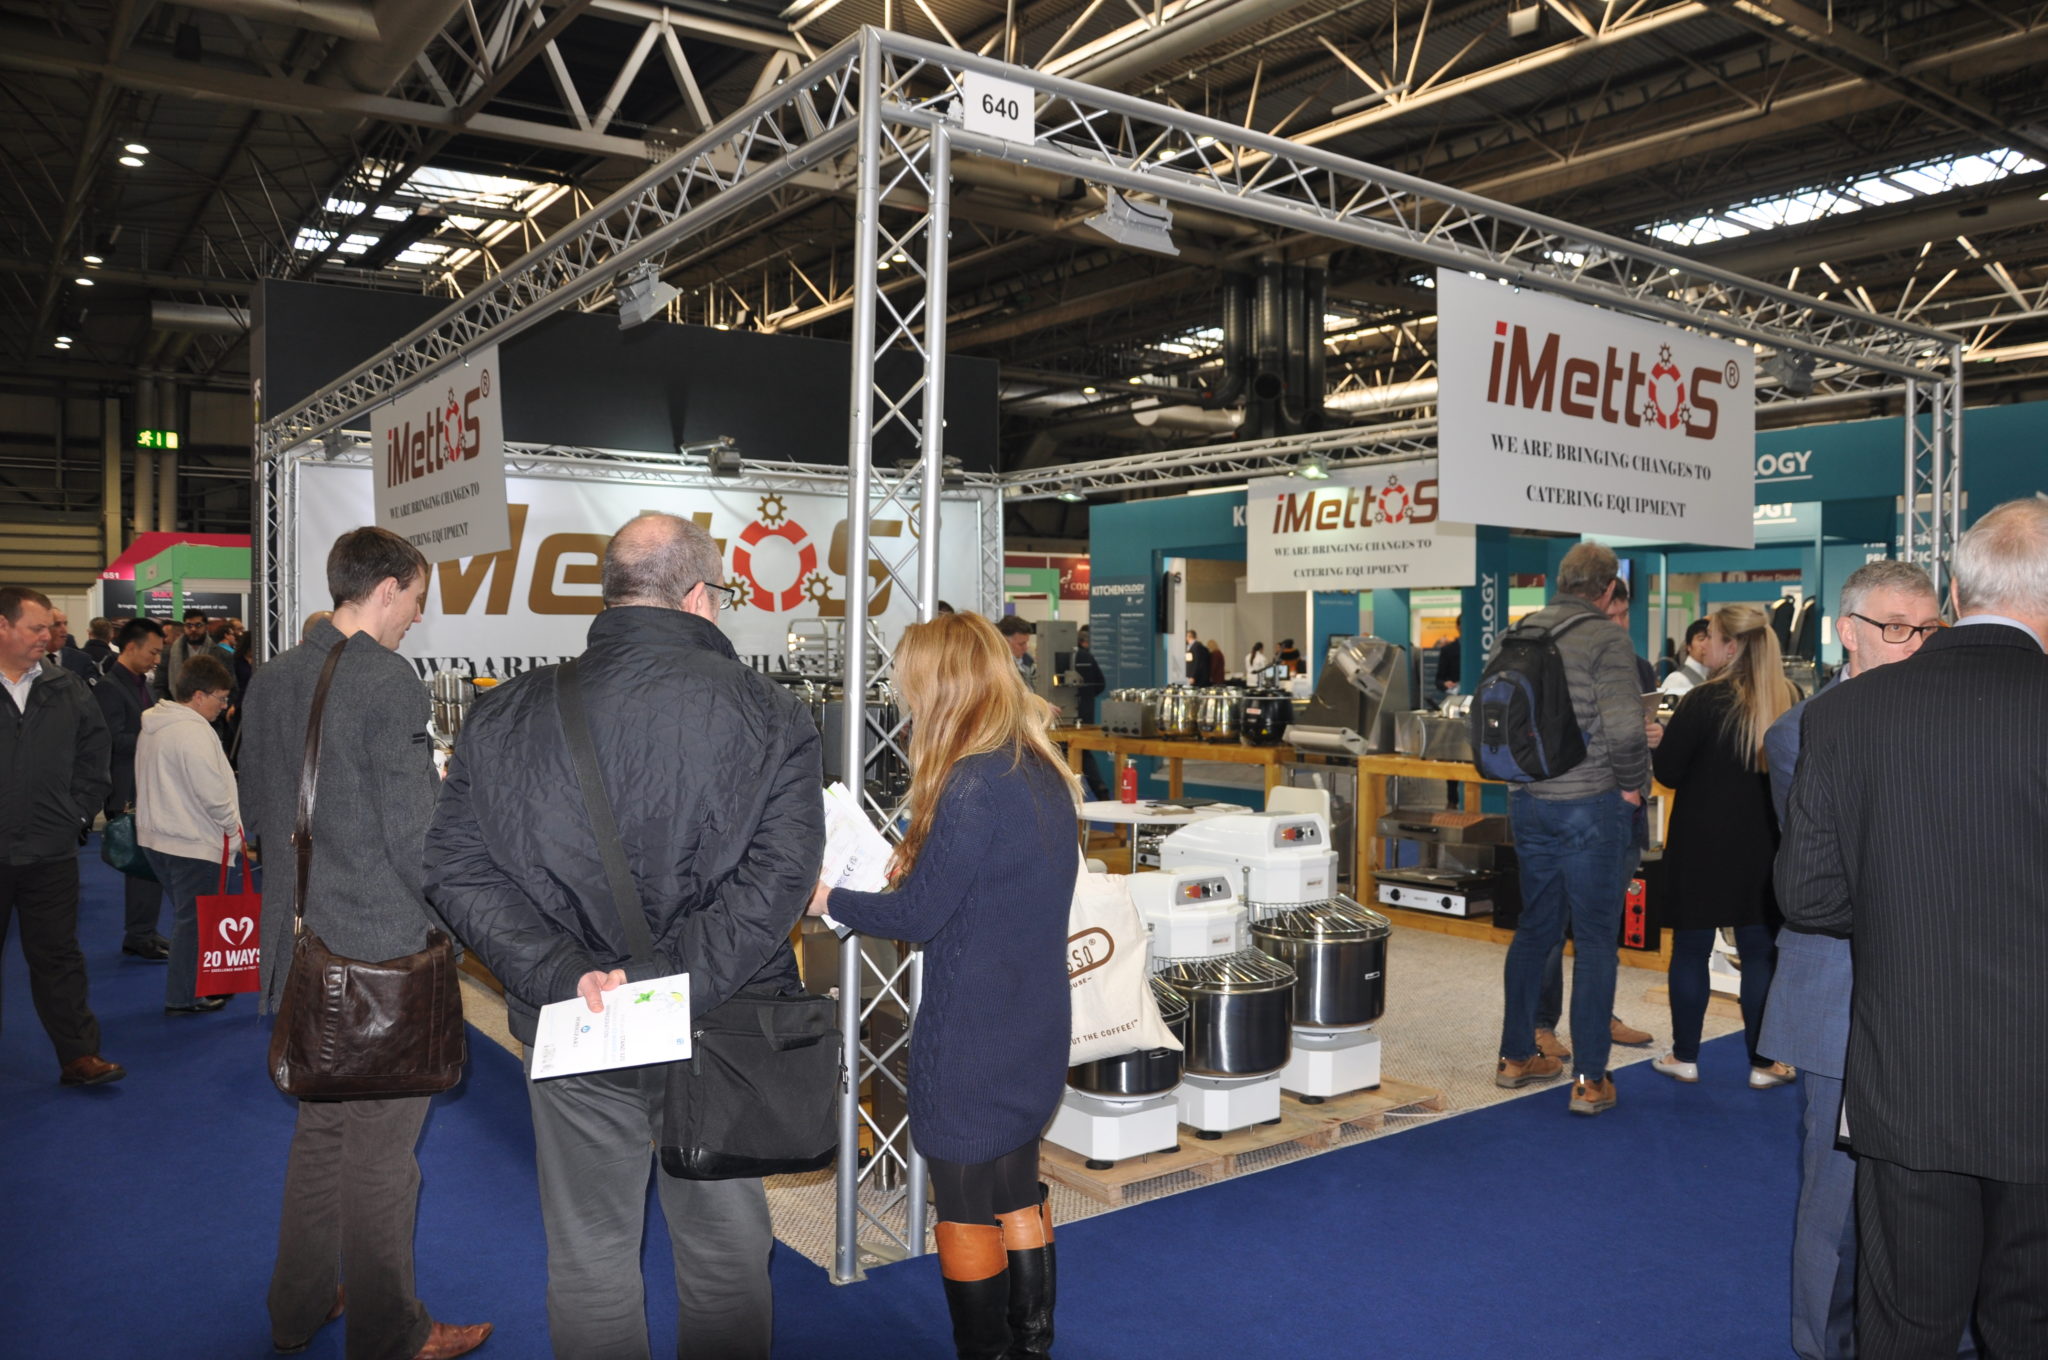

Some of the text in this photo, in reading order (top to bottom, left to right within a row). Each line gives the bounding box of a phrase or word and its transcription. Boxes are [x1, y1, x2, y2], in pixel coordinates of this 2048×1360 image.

[982, 93, 1019, 120] 640
[1491, 433, 1711, 481] WE ARE BRINGING CHANGES TO
[1753, 450, 1812, 476] OGY
[390, 481, 480, 519] WE ARE BRINGING CHANGES TO
[1526, 484, 1687, 518] CATERING EQUIPMENT
[432, 522, 469, 544] EQUIPMENT
[1274, 539, 1432, 556] WE ARE BRINGING CHANGES TO
[1293, 564, 1409, 577] CATERING EQUIPMENT
[203, 951, 222, 967] 20
[1083, 1032, 1099, 1042] THE
